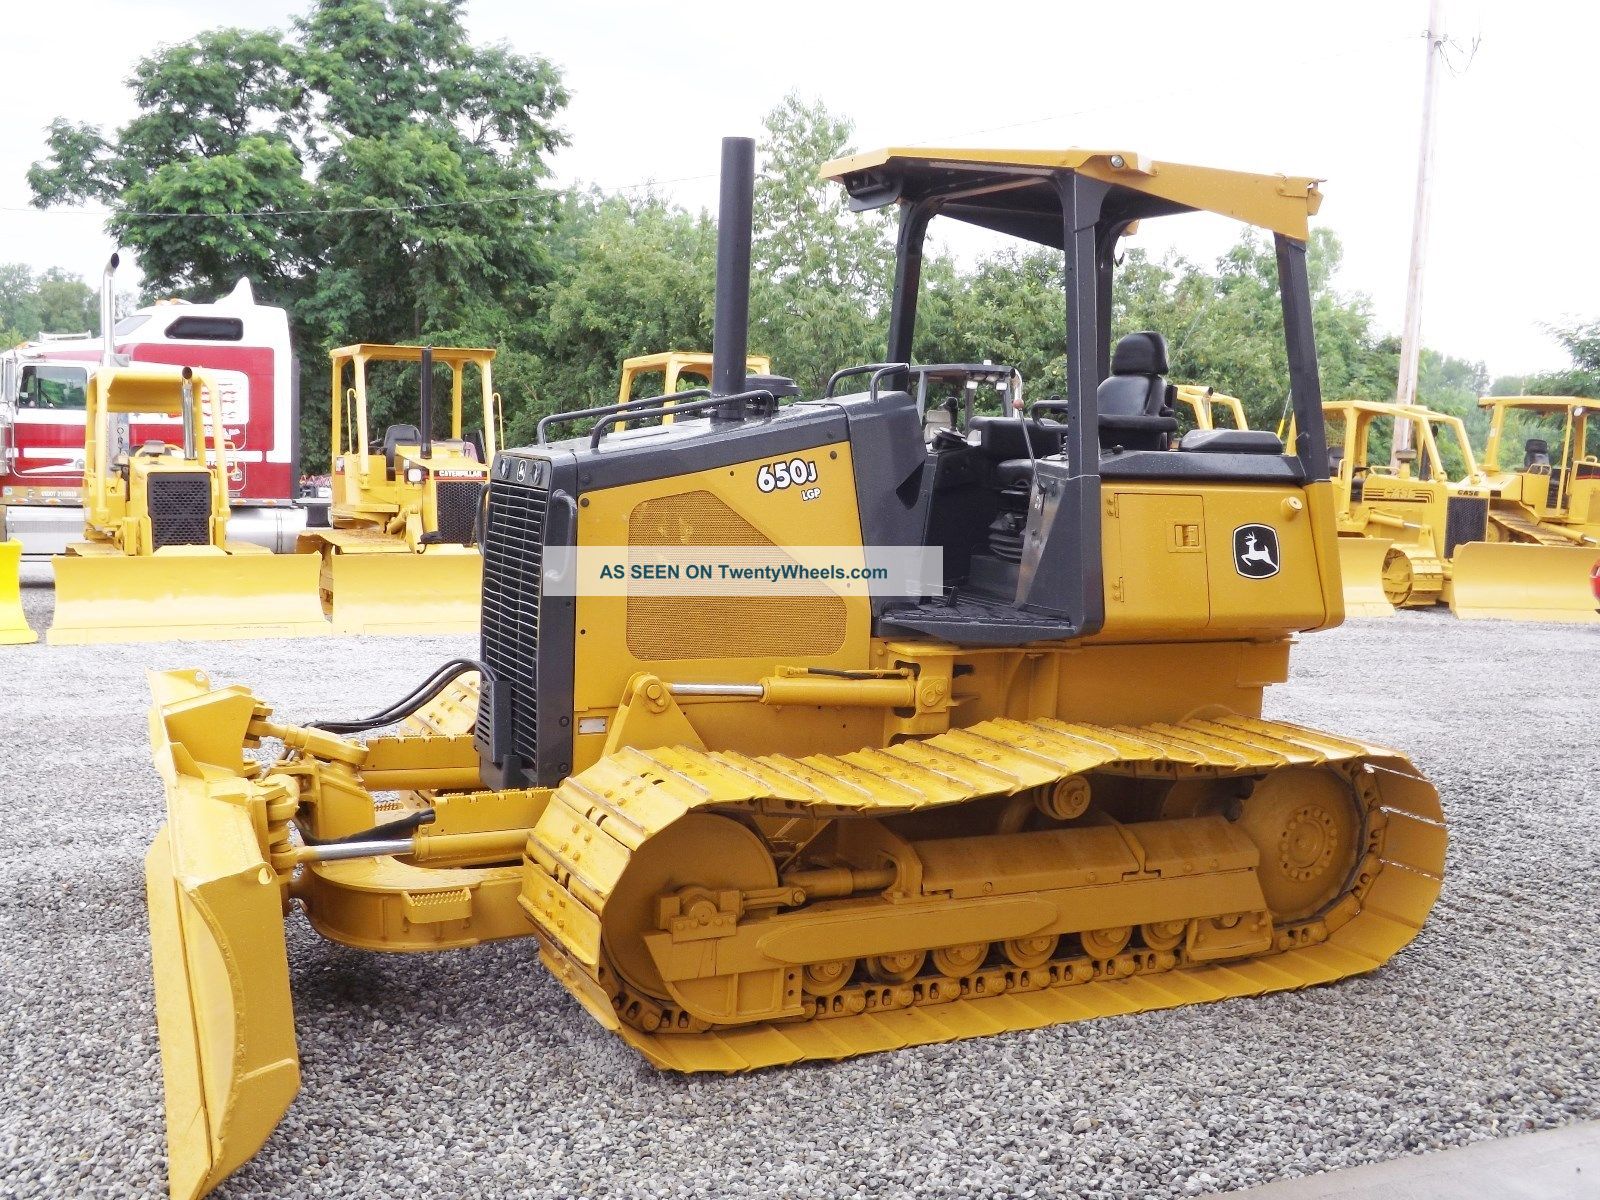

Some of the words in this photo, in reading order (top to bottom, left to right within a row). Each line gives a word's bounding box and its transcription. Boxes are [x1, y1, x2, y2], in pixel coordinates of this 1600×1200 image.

[438, 470, 483, 478] CATERPILLAR
[756, 458, 818, 493] 650J
[801, 487, 822, 501] LGP
[1457, 489, 1480, 497] CASE
